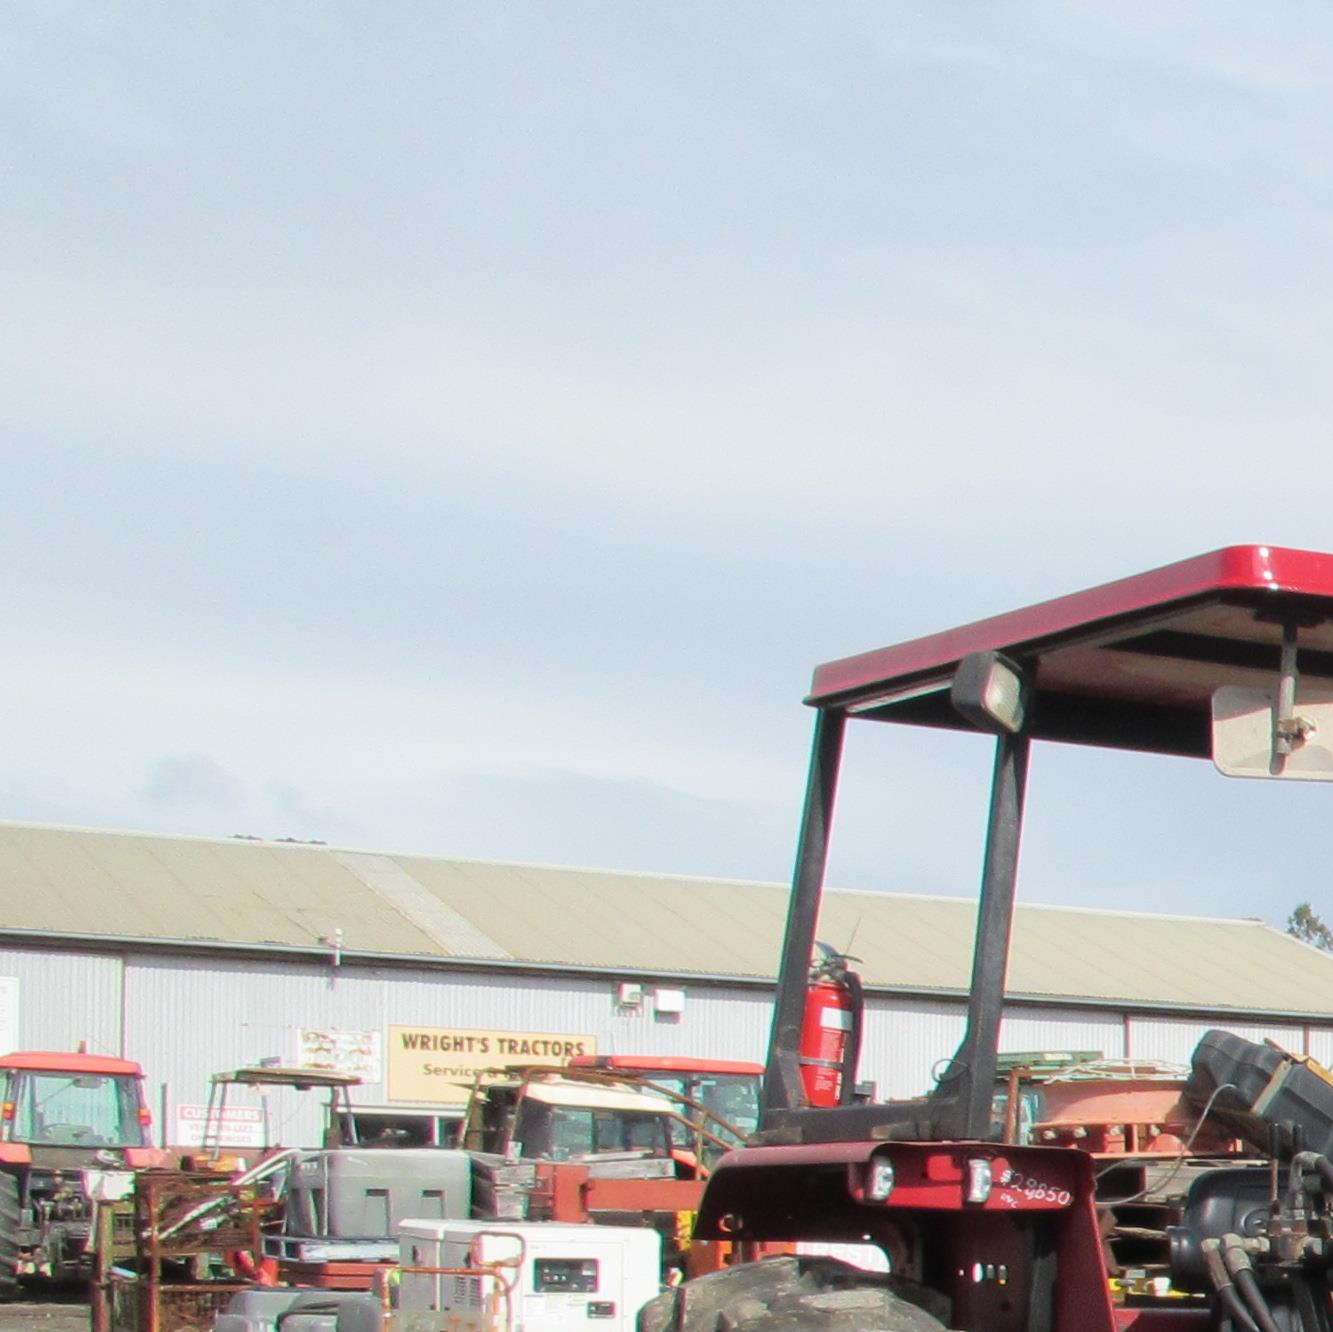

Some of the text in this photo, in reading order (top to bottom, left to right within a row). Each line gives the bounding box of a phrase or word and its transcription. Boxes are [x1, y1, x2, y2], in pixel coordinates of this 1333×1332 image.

[402, 1033, 585, 1057] WRIGHT'S TRACTORS
[423, 1063, 482, 1078] Service
